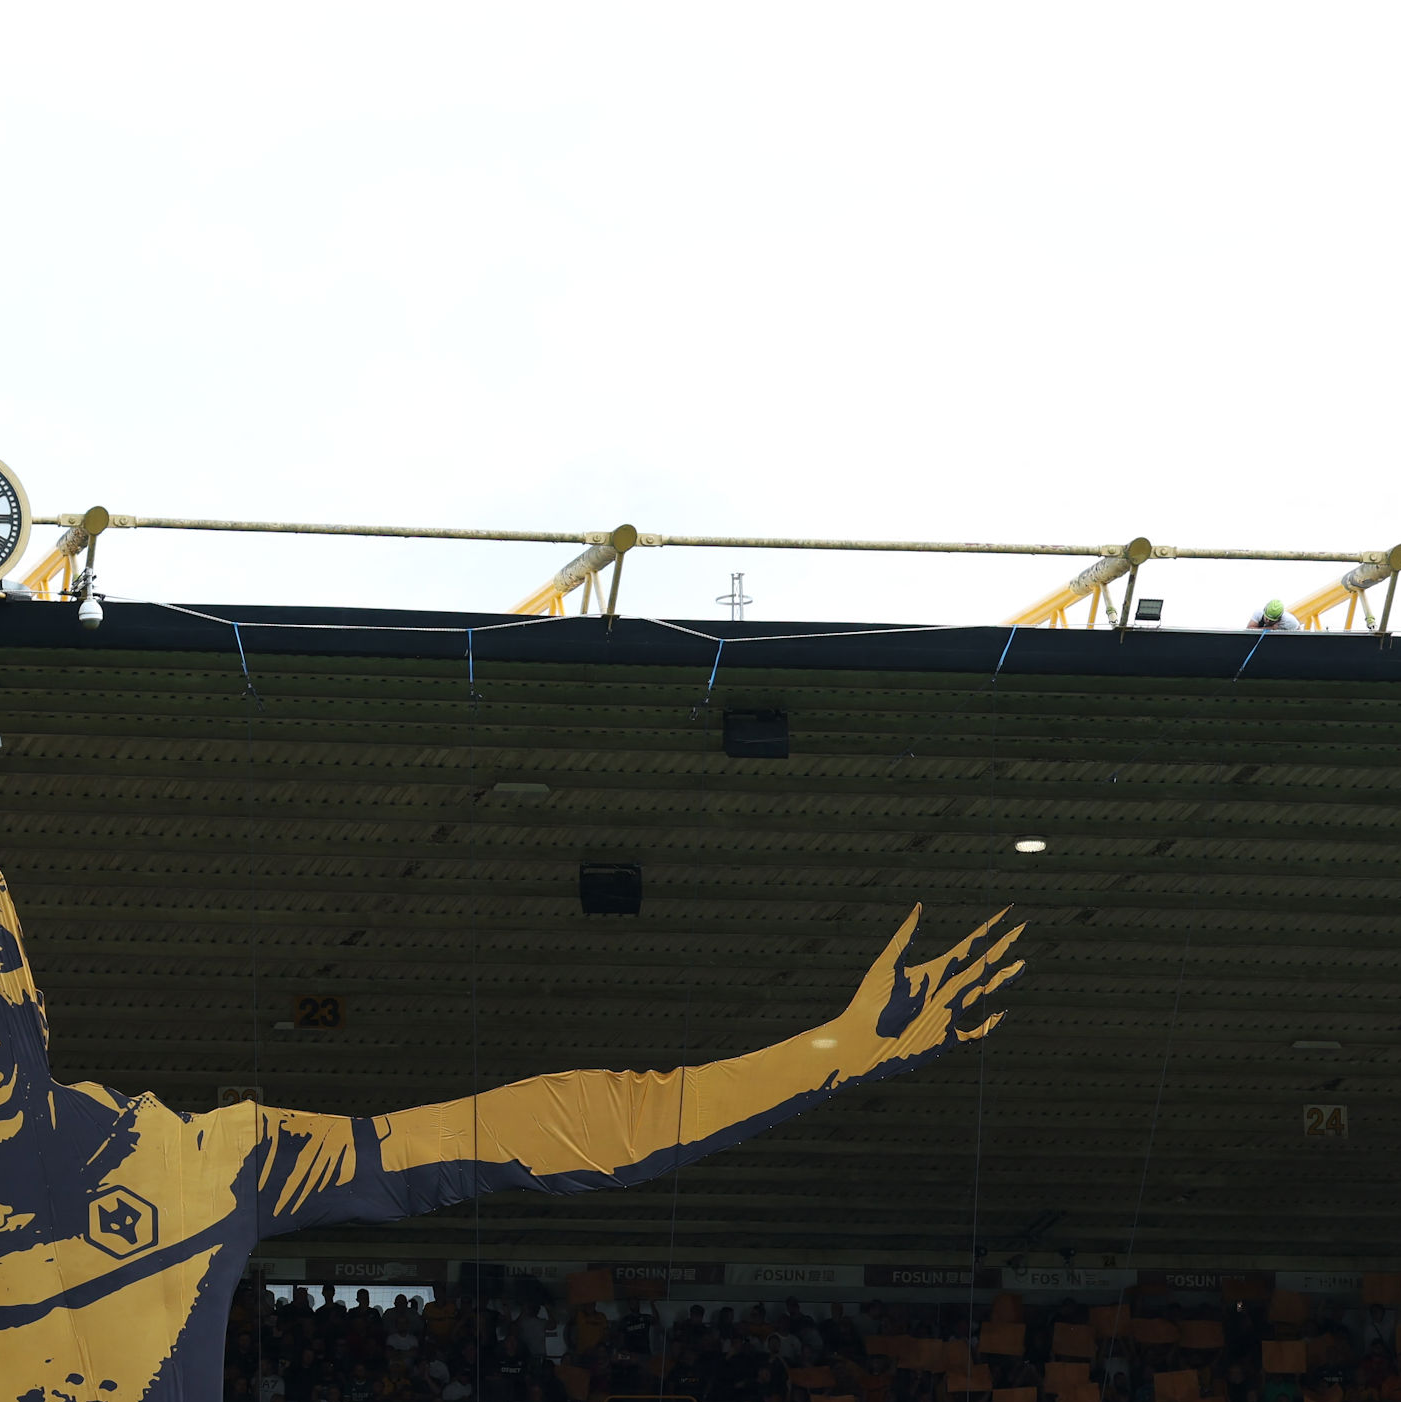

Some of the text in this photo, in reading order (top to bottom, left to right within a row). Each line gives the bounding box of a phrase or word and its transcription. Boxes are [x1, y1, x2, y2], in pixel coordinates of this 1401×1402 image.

[298, 998, 340, 1027] 23
[1307, 1110, 1344, 1135] 24
[335, 1263, 385, 1276] FOSUN
[755, 1269, 802, 1281] FOSUN
